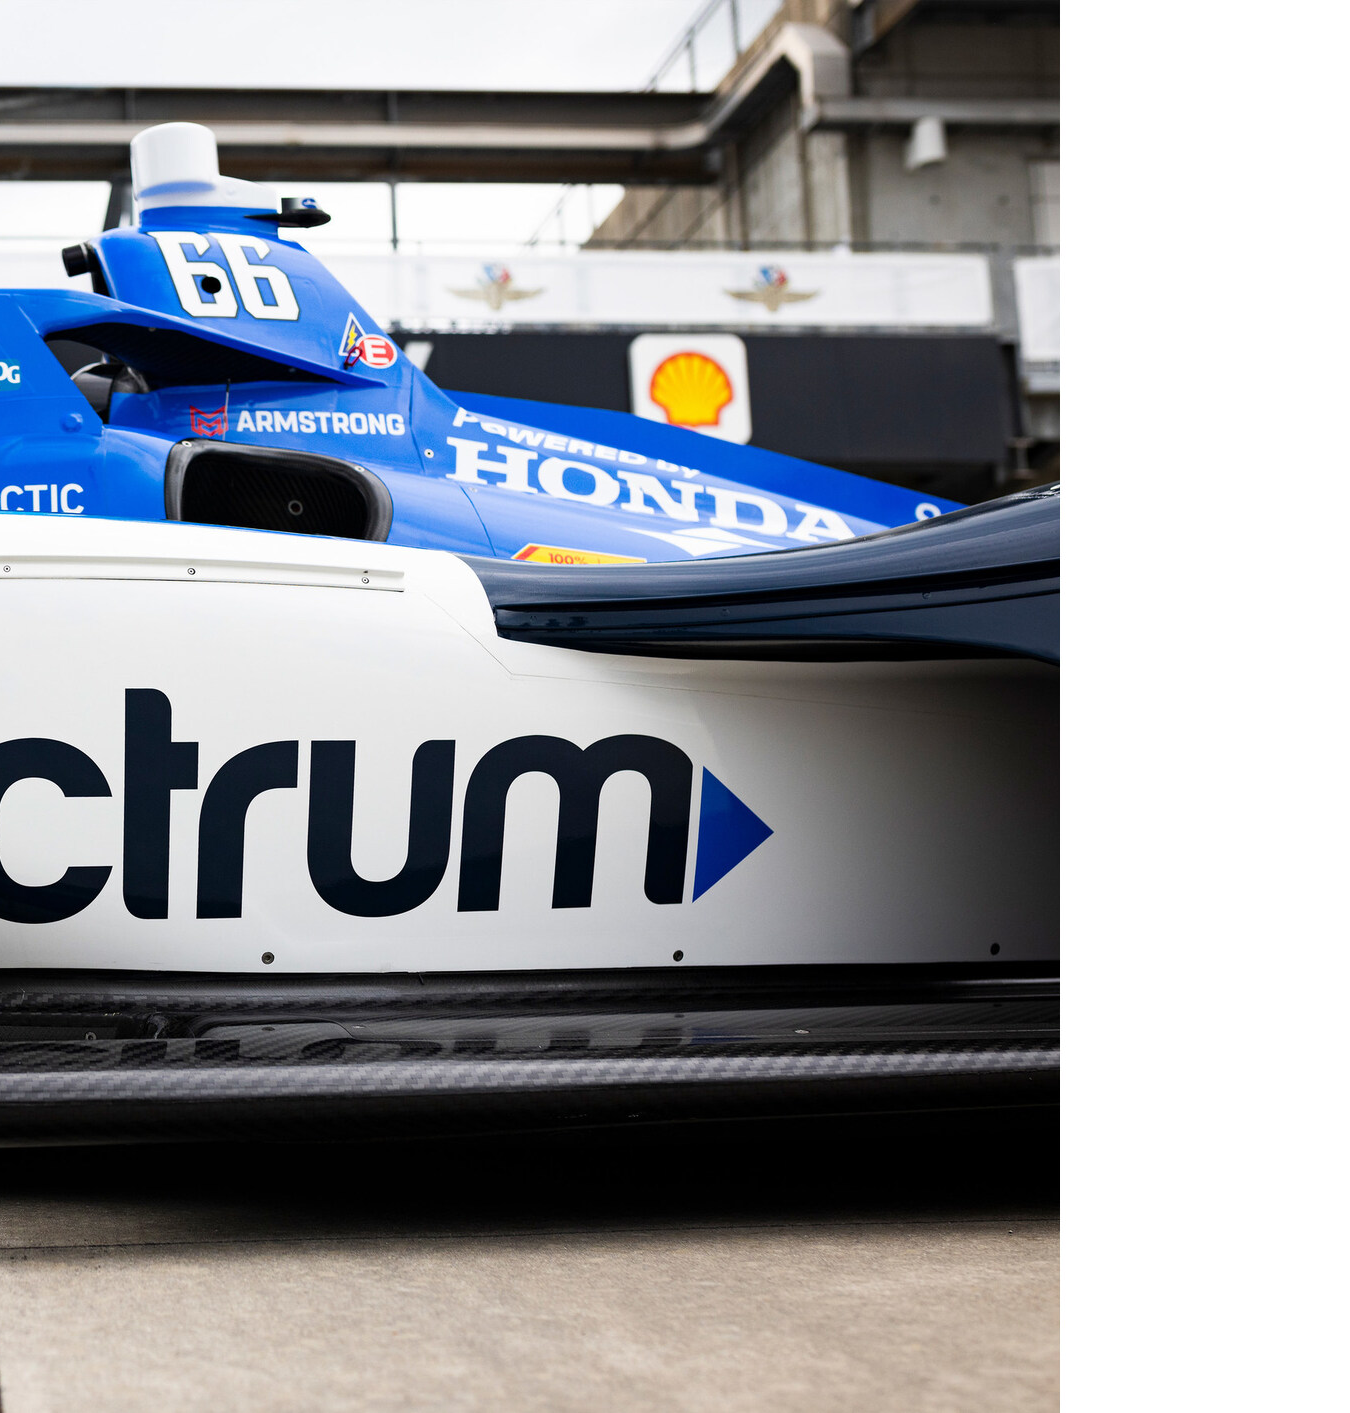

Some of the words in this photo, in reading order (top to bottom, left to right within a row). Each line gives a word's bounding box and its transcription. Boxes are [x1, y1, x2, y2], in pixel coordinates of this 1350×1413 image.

[147, 231, 300, 321] 66
[363, 339, 391, 364] E
[236, 410, 406, 436] ARMSTRONG
[452, 406, 648, 466] POWERED
[445, 436, 856, 542] HONDA
